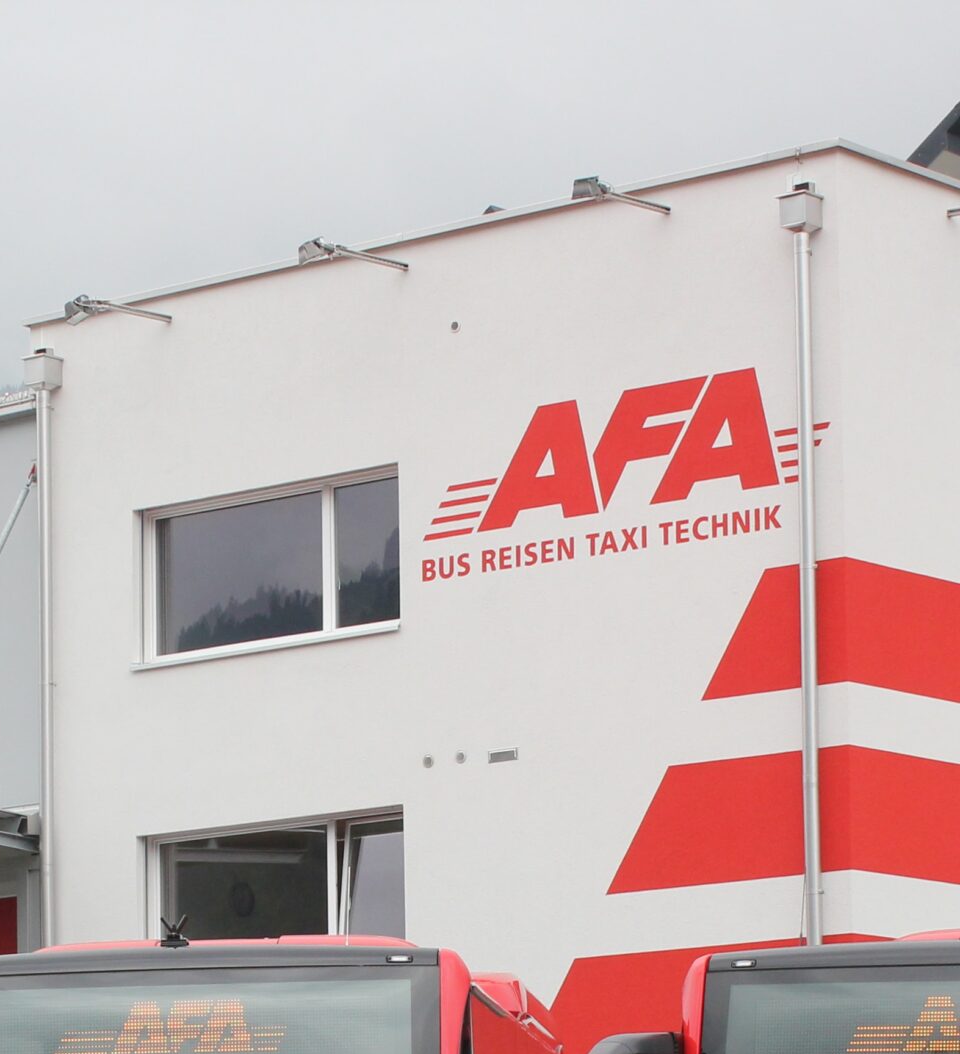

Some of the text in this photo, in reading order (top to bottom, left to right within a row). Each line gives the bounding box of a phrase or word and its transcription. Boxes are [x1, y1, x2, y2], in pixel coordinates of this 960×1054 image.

[477, 367, 780, 533] AFA
[421, 504, 782, 583] BUS REISEN TAXI TECHNIK
[111, 999, 254, 1054] AFA
